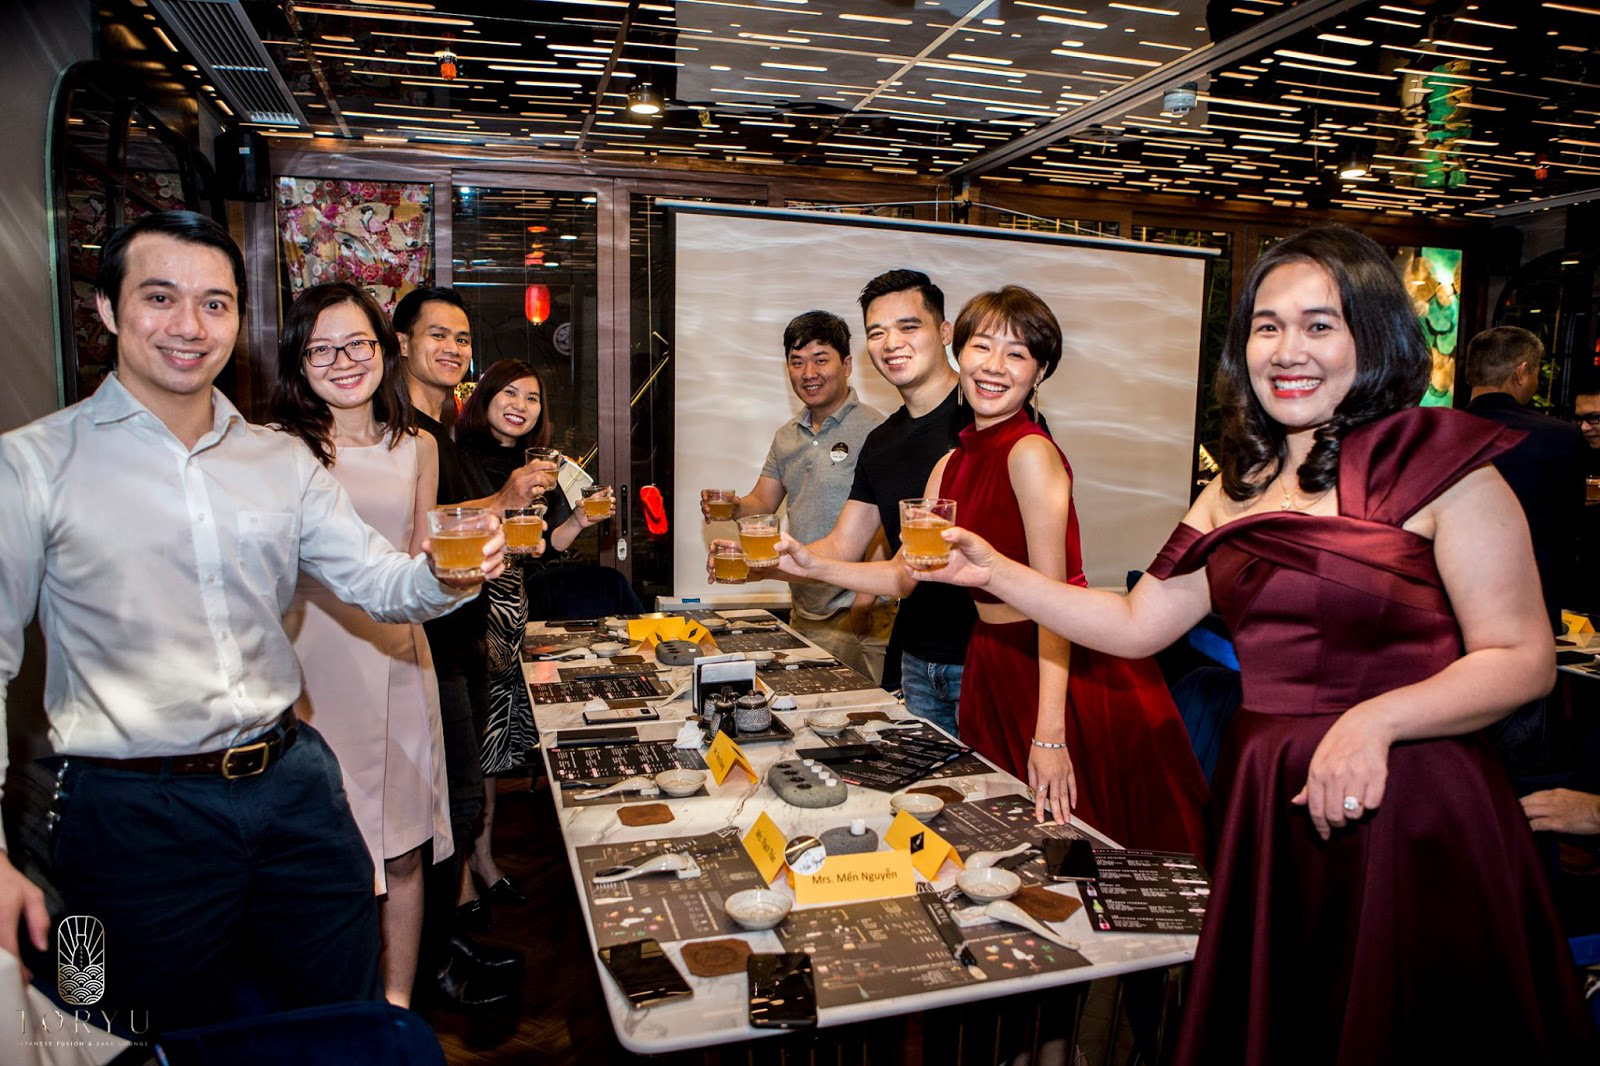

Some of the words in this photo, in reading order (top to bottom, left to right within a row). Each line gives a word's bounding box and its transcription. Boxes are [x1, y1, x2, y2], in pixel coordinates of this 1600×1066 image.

[812, 875, 834, 885] Mrs.
[836, 872, 859, 883] Mến
[861, 867, 898, 883] Nguyễn
